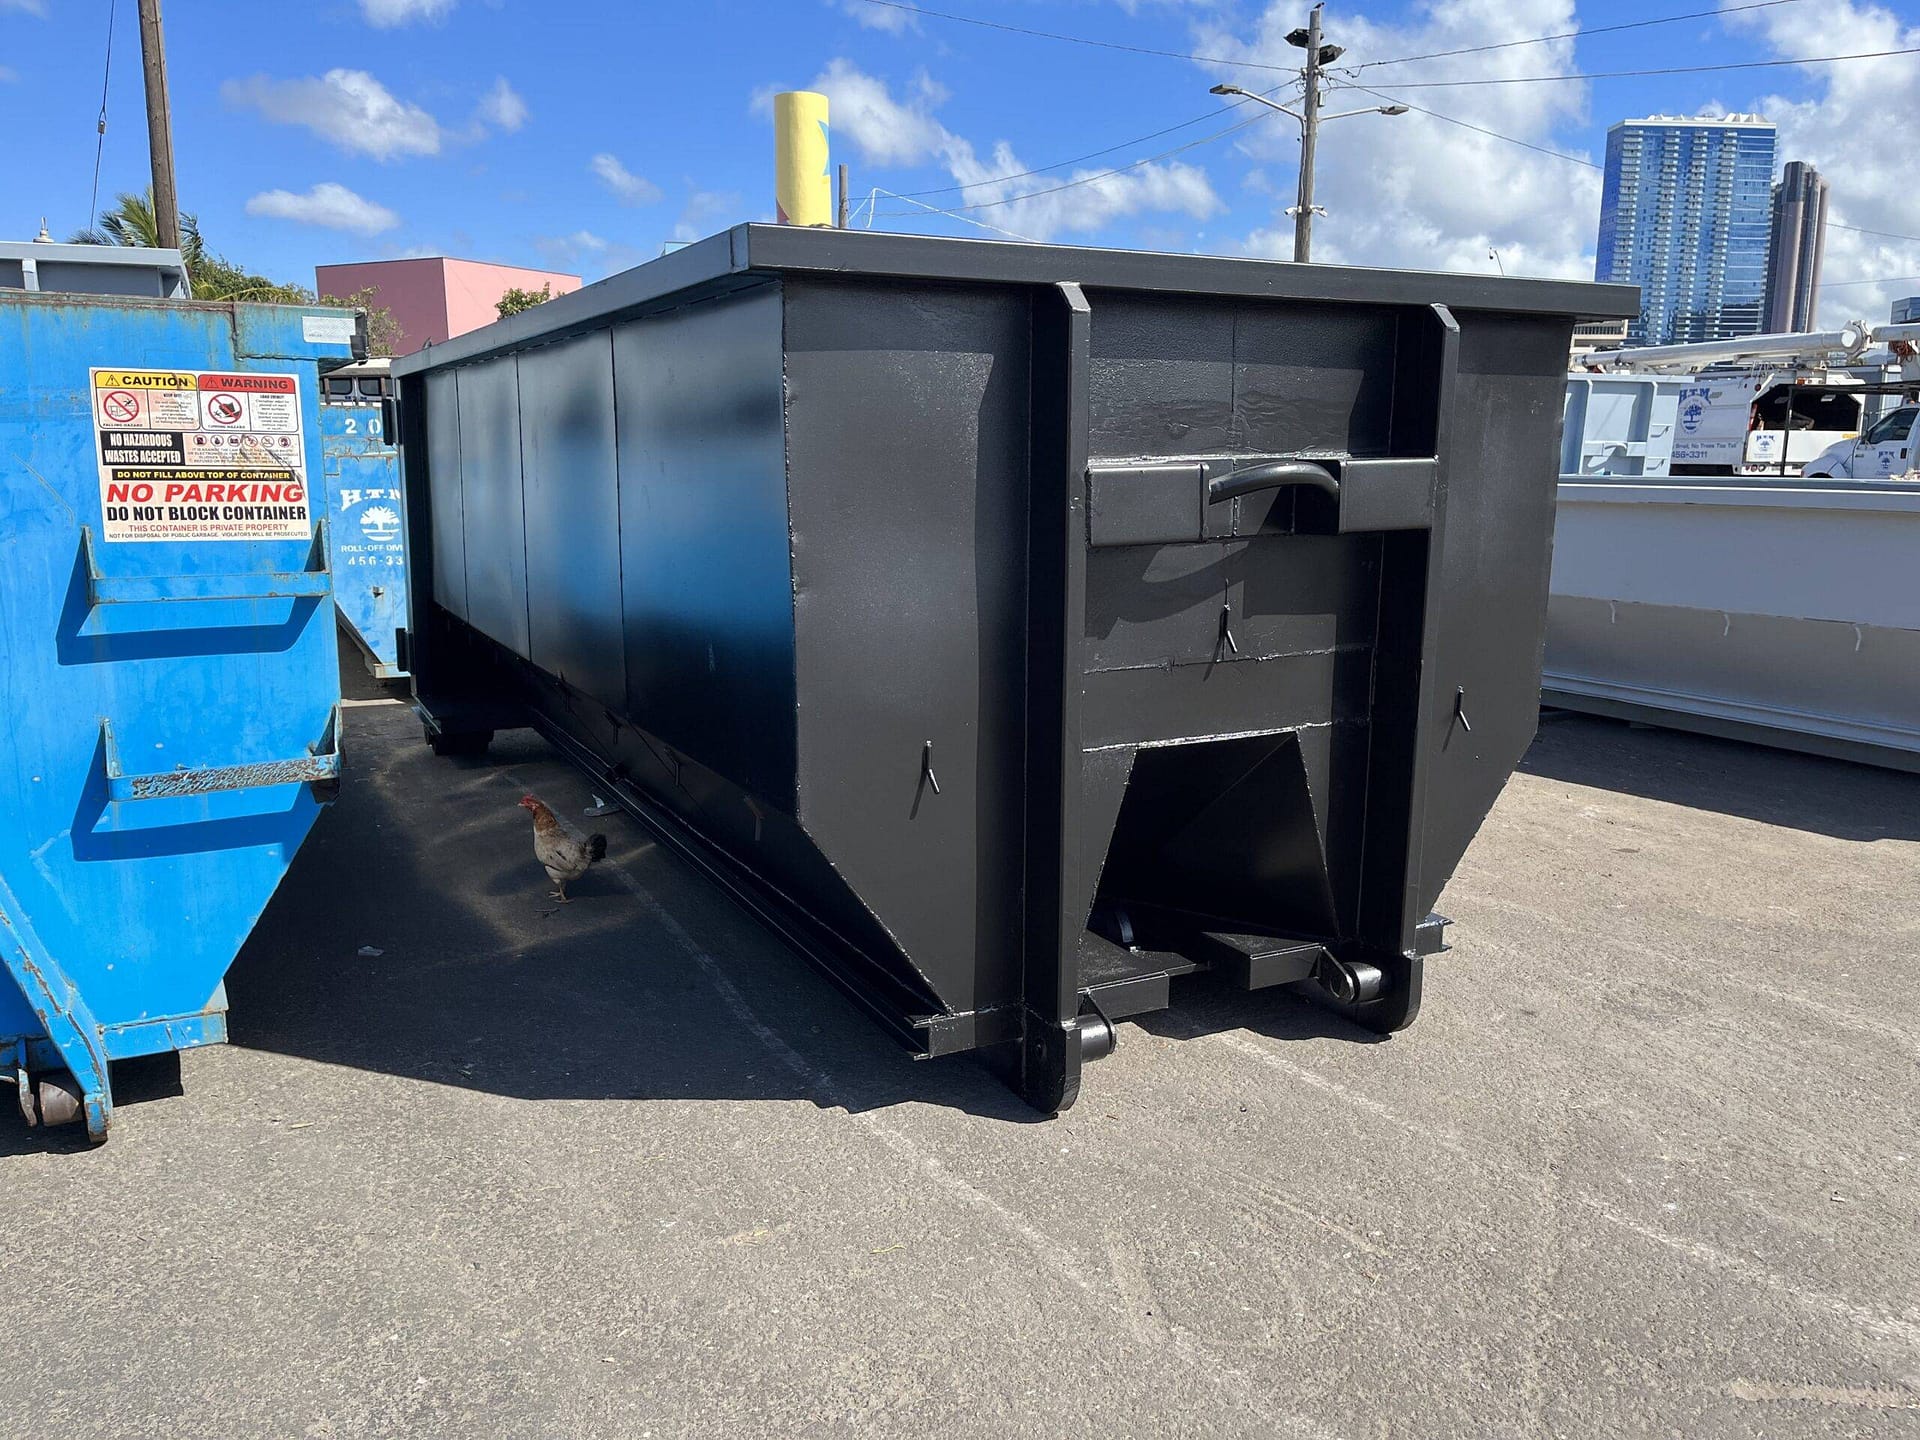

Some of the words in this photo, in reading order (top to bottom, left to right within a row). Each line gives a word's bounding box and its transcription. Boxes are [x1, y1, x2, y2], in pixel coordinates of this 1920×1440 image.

[122, 376, 188, 387] CAUTION
[221, 378, 288, 389] WARNING
[110, 433, 121, 446] NO
[123, 433, 173, 447] HAZARDOUS
[104, 450, 139, 463] WASTES
[140, 450, 181, 463] ACCEPTED
[107, 484, 153, 502] NO
[165, 484, 303, 503] PARKING
[107, 506, 129, 521] DO
[133, 506, 164, 521] NOT
[168, 506, 220, 521] BLOCK
[222, 506, 307, 520] CONTAINER
[128, 524, 148, 532] THIS
[150, 524, 198, 532] CONTAINER
[246, 523, 289, 531] PROPERTY
